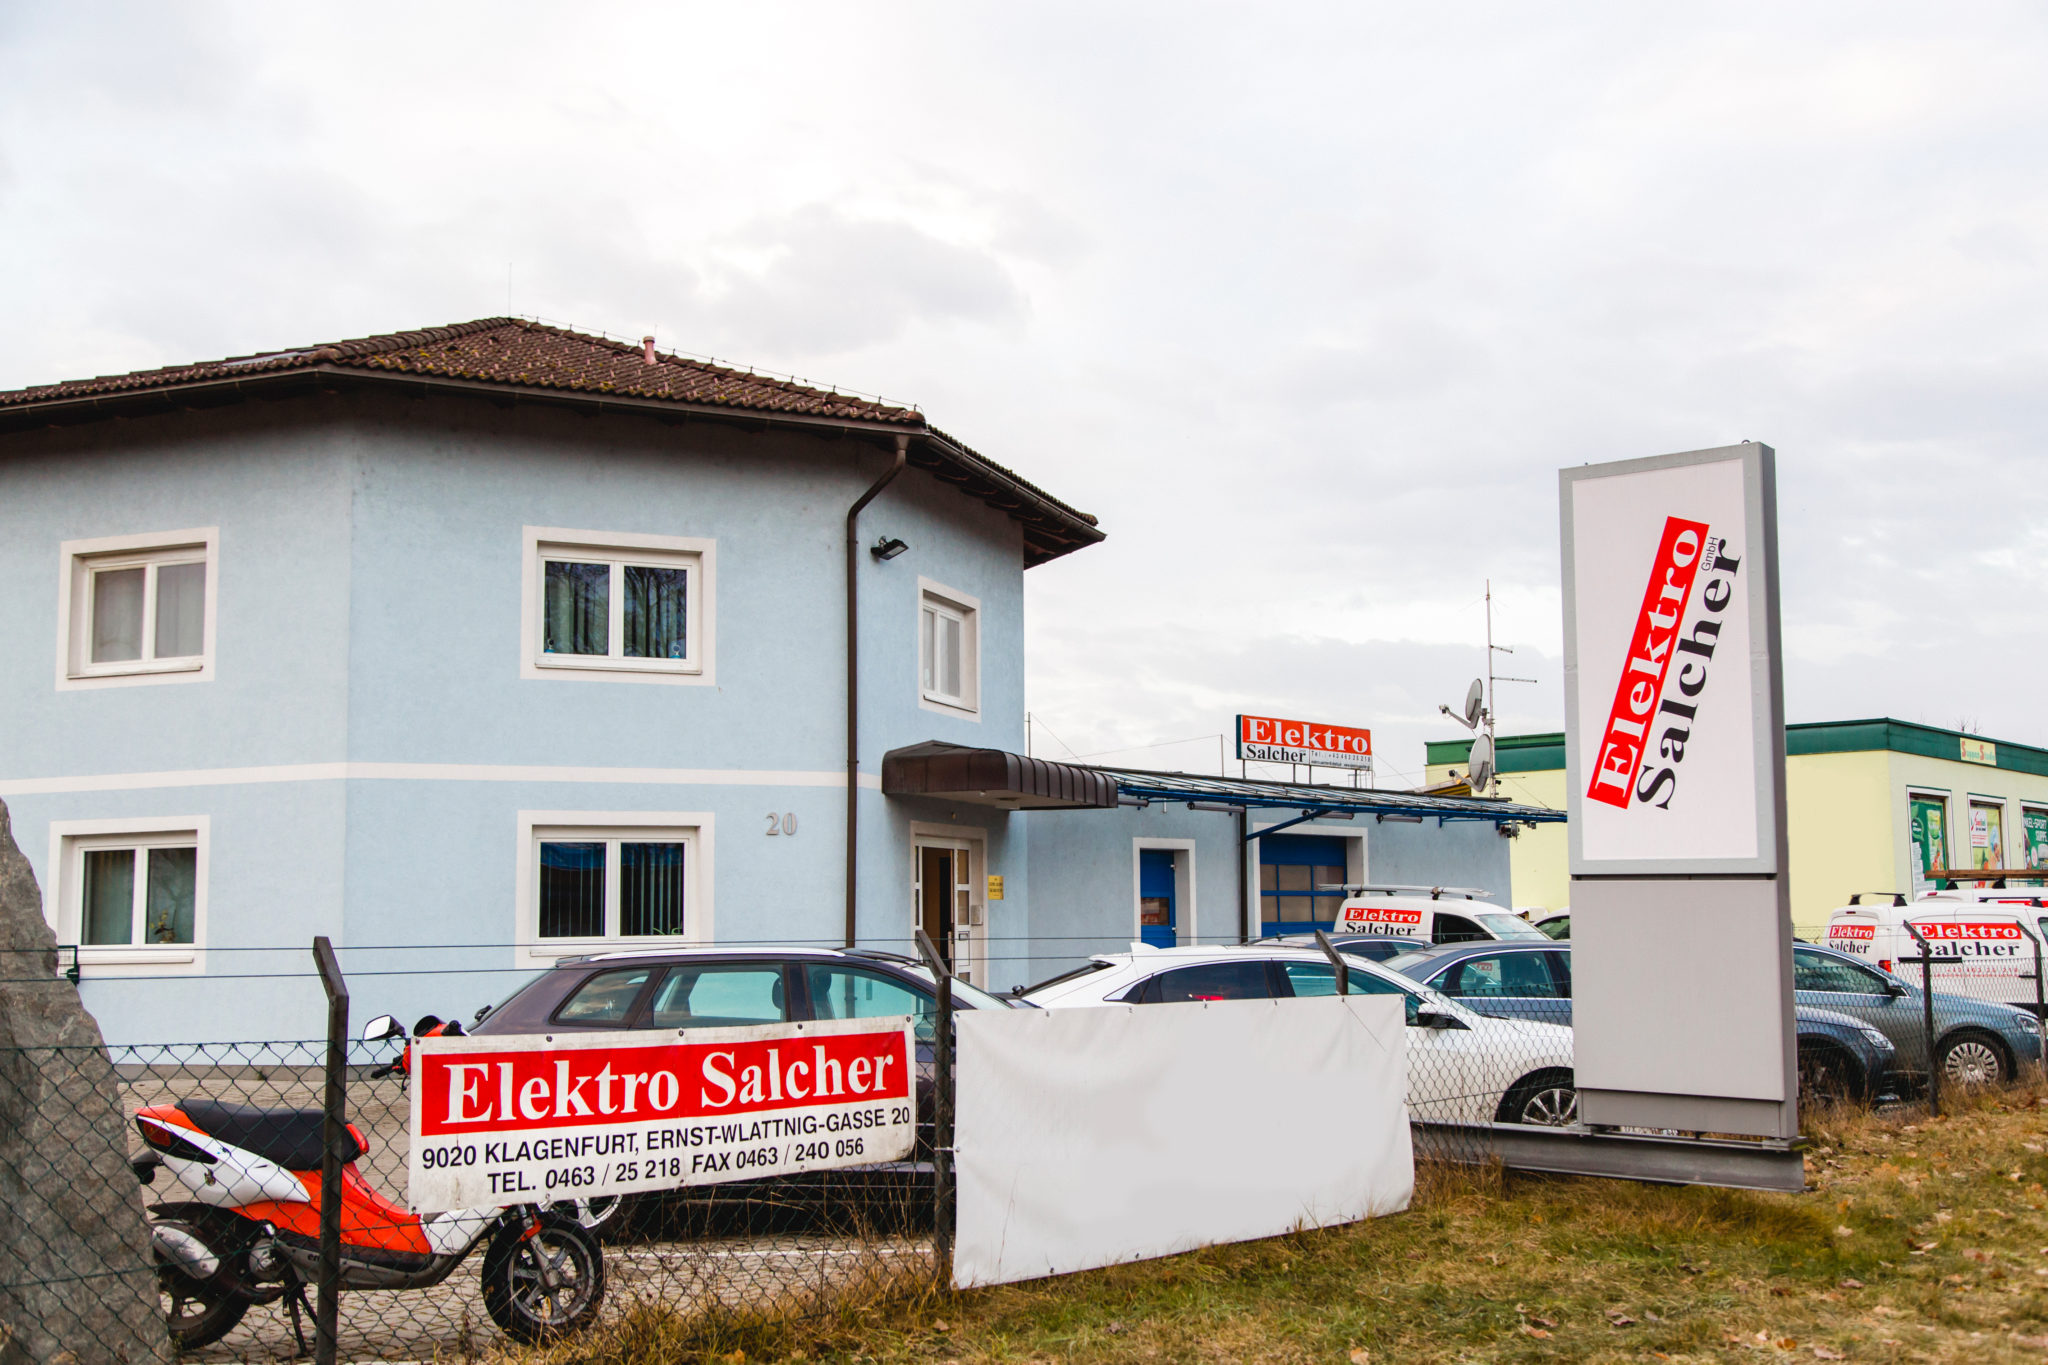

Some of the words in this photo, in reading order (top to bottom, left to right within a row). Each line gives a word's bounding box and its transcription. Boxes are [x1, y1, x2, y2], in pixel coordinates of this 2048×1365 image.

[1701, 536, 1718, 572] GmbH
[1594, 529, 1699, 798] Elektro
[1637, 538, 1742, 810] Salcher
[1246, 717, 1368, 754] Elektro
[1246, 743, 1306, 763] Salcher
[766, 812, 798, 835] 20
[1345, 921, 1416, 936] Salcher
[1348, 909, 1419, 922] Elektro
[1831, 926, 1873, 938] Elektro
[1915, 924, 2018, 938] Elektro
[1829, 940, 1870, 953] Salcher
[440, 1059, 680, 1124] Elektro
[700, 1044, 894, 1109] Salcher
[422, 1145, 477, 1169] 9020
[485, 1132, 639, 1164] KLAGENFURT,
[647, 1107, 886, 1149] ERNST-WLATTNIG-GASSE
[891, 1106, 910, 1125] 20
[487, 1171, 537, 1194] TEL.
[545, 1165, 595, 1189] 0463
[601, 1163, 610, 1186] /
[615, 1161, 638, 1182] 25
[645, 1157, 680, 1178] 218
[691, 1152, 731, 1173] FAX
[736, 1147, 778, 1169] 0463
[784, 1143, 791, 1165] /
[795, 1141, 830, 1162] 240
[835, 1137, 864, 1157] 056
